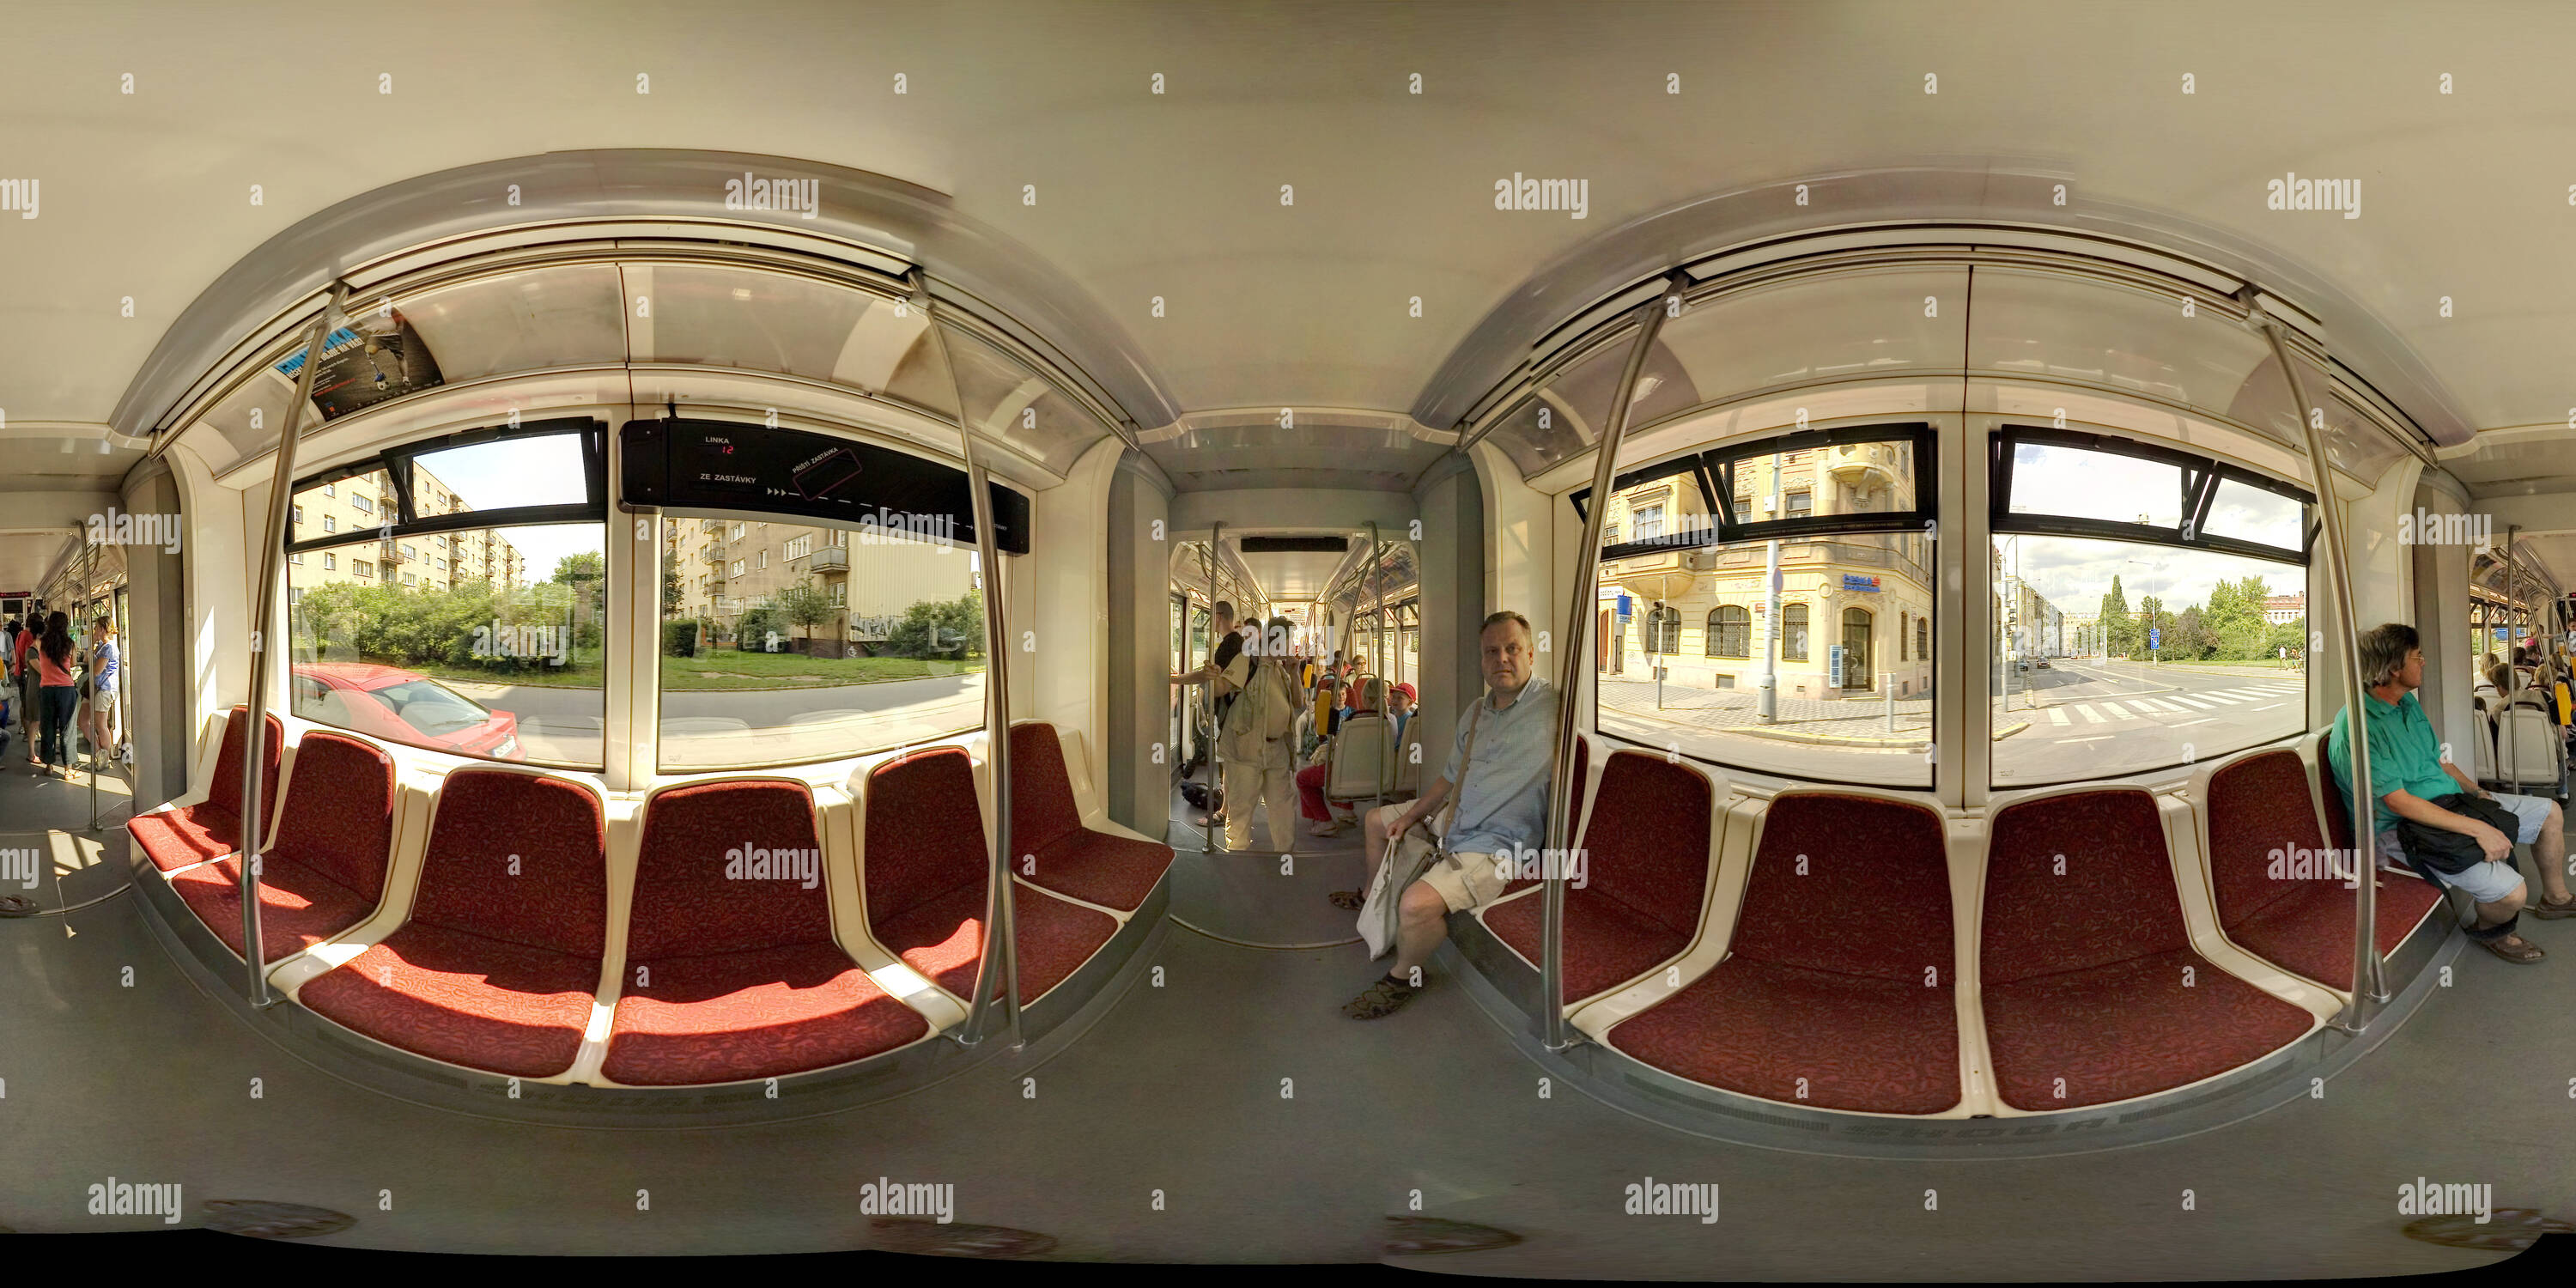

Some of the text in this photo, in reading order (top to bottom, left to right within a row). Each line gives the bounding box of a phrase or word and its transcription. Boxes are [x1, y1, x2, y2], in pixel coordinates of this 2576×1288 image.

[705, 436, 730, 445] LINKA
[721, 446, 734, 454] 12
[811, 447, 839, 465] ZASTÁVKA
[700, 472, 756, 484] ZE ZASTÁVKY
